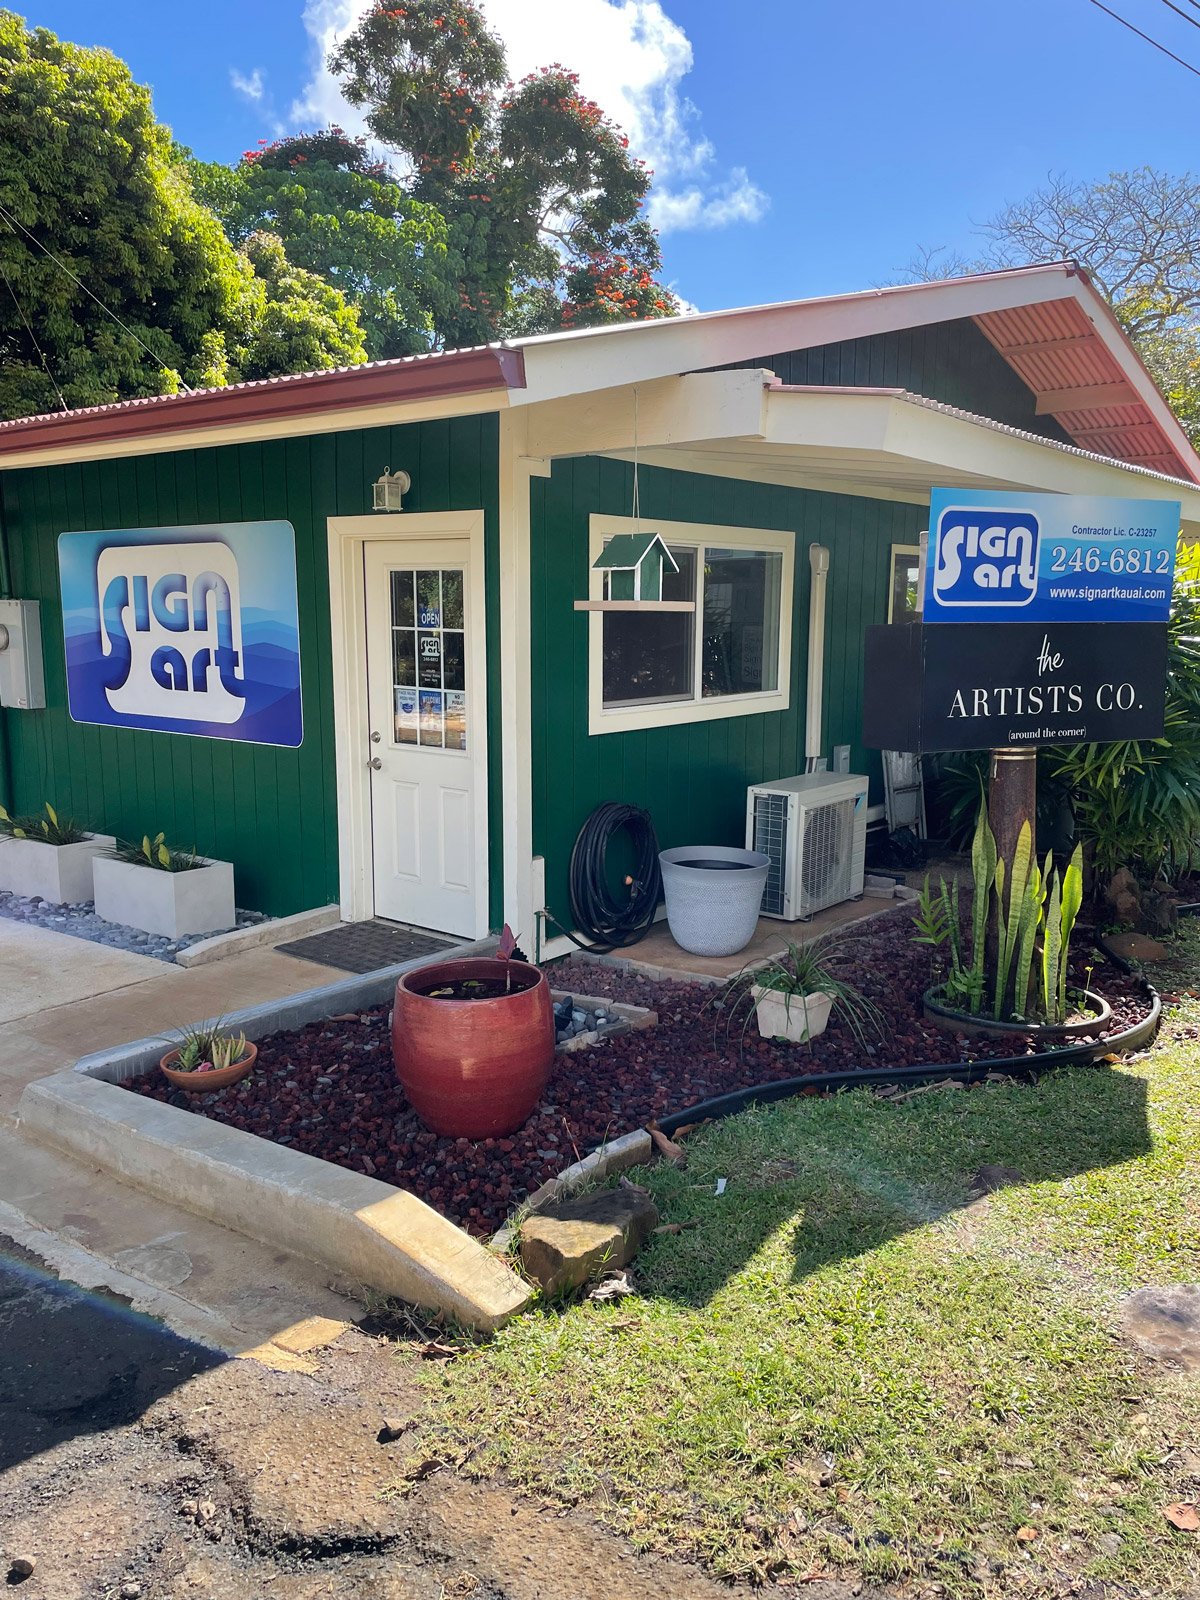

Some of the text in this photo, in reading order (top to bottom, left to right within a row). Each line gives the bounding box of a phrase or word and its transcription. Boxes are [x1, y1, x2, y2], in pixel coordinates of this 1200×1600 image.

[1072, 525, 1157, 538] Contractor Lic. C-23257
[1051, 546, 1170, 574] 246-6812
[973, 563, 1035, 589] art
[1050, 586, 1166, 602] www.signartkauai.com
[421, 613, 440, 625] OPEN
[1036, 634, 1065, 676] the
[150, 641, 246, 698] art
[947, 682, 1143, 718] ARTISTS CO.
[1008, 725, 1087, 742] (around the corner)
